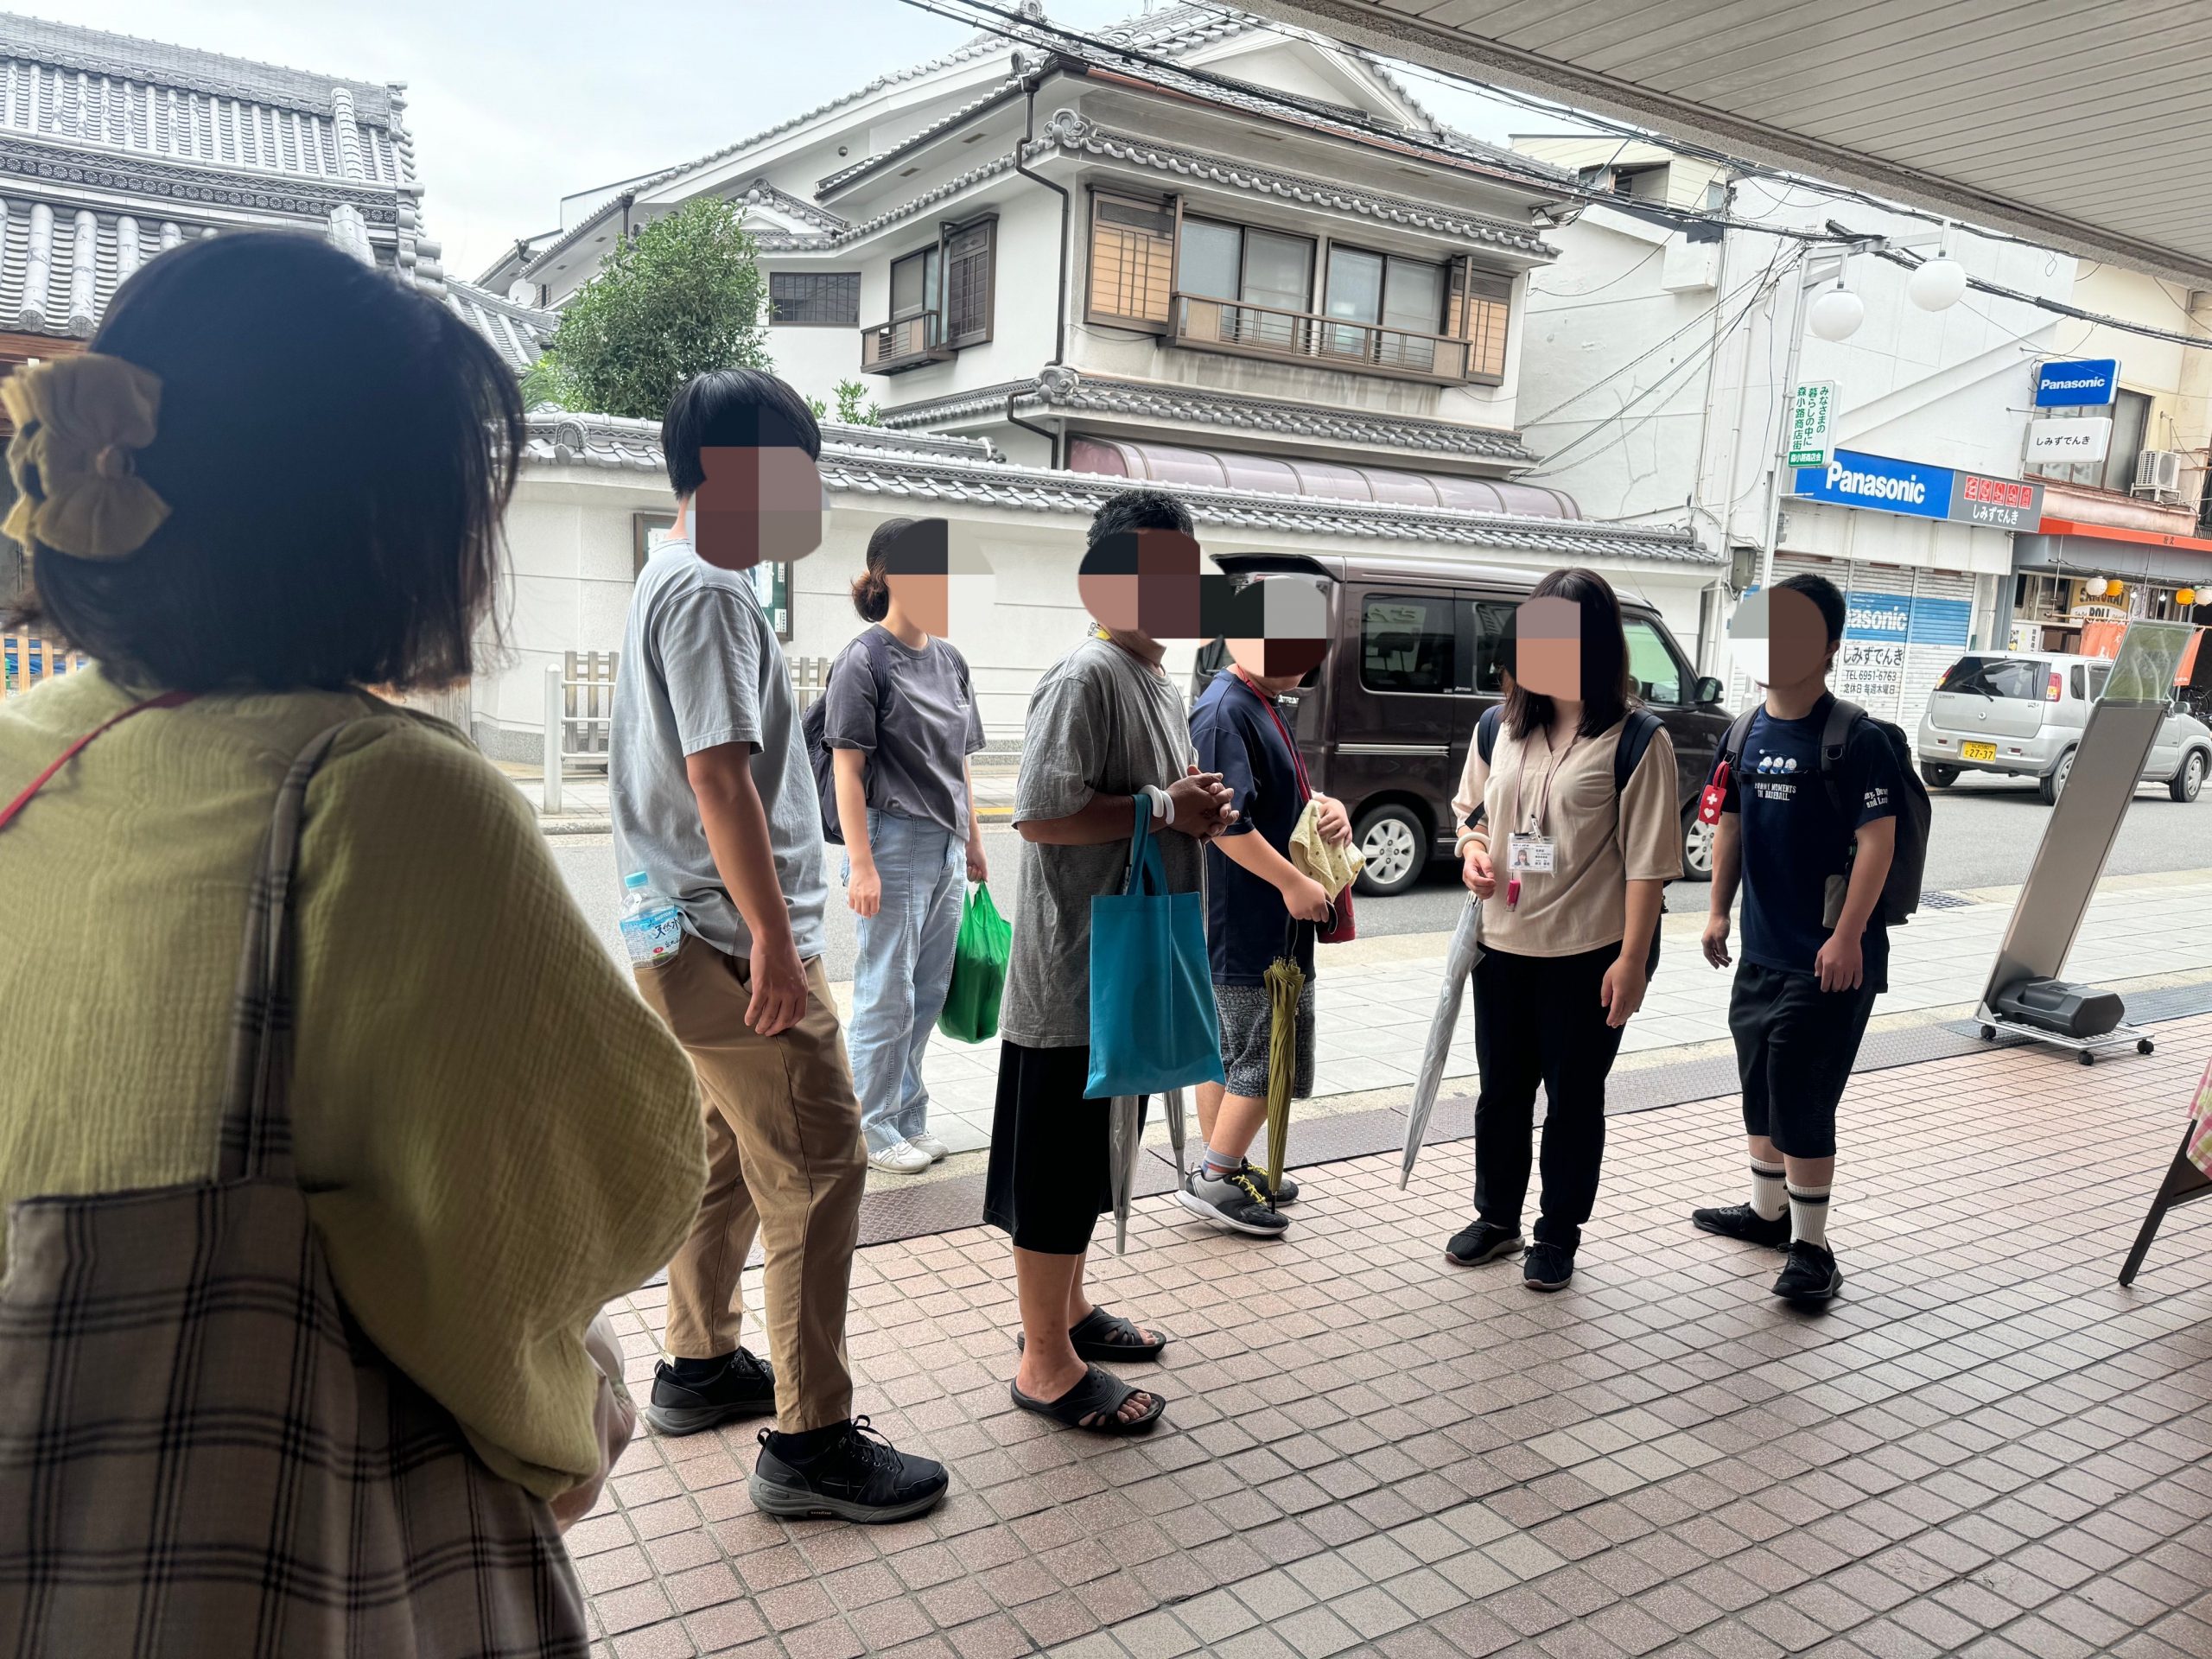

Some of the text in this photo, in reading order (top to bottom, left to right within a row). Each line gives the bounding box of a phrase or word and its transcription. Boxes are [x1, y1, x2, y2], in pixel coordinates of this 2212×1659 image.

[2040, 376, 2106, 390] Panasonic
[1793, 386, 1807, 450] 森小路商店街
[1802, 387, 1818, 446] 暮らしの中に
[1816, 386, 1829, 434] みなさまの
[2036, 435, 2090, 446] しみずでんき
[1825, 461, 1925, 505] Panasonic
[1972, 503, 2019, 525] しみずでんき
[1843, 645, 1904, 666] しみずでんき
[1845, 670, 1897, 682] TEL 6951-6763
[1843, 683, 1896, 695] 定休日 毎週木曜日
[1969, 748, 1994, 760] 27-37
[1771, 783, 1797, 794] MOMENTS
[654, 917, 680, 939] 天然水
